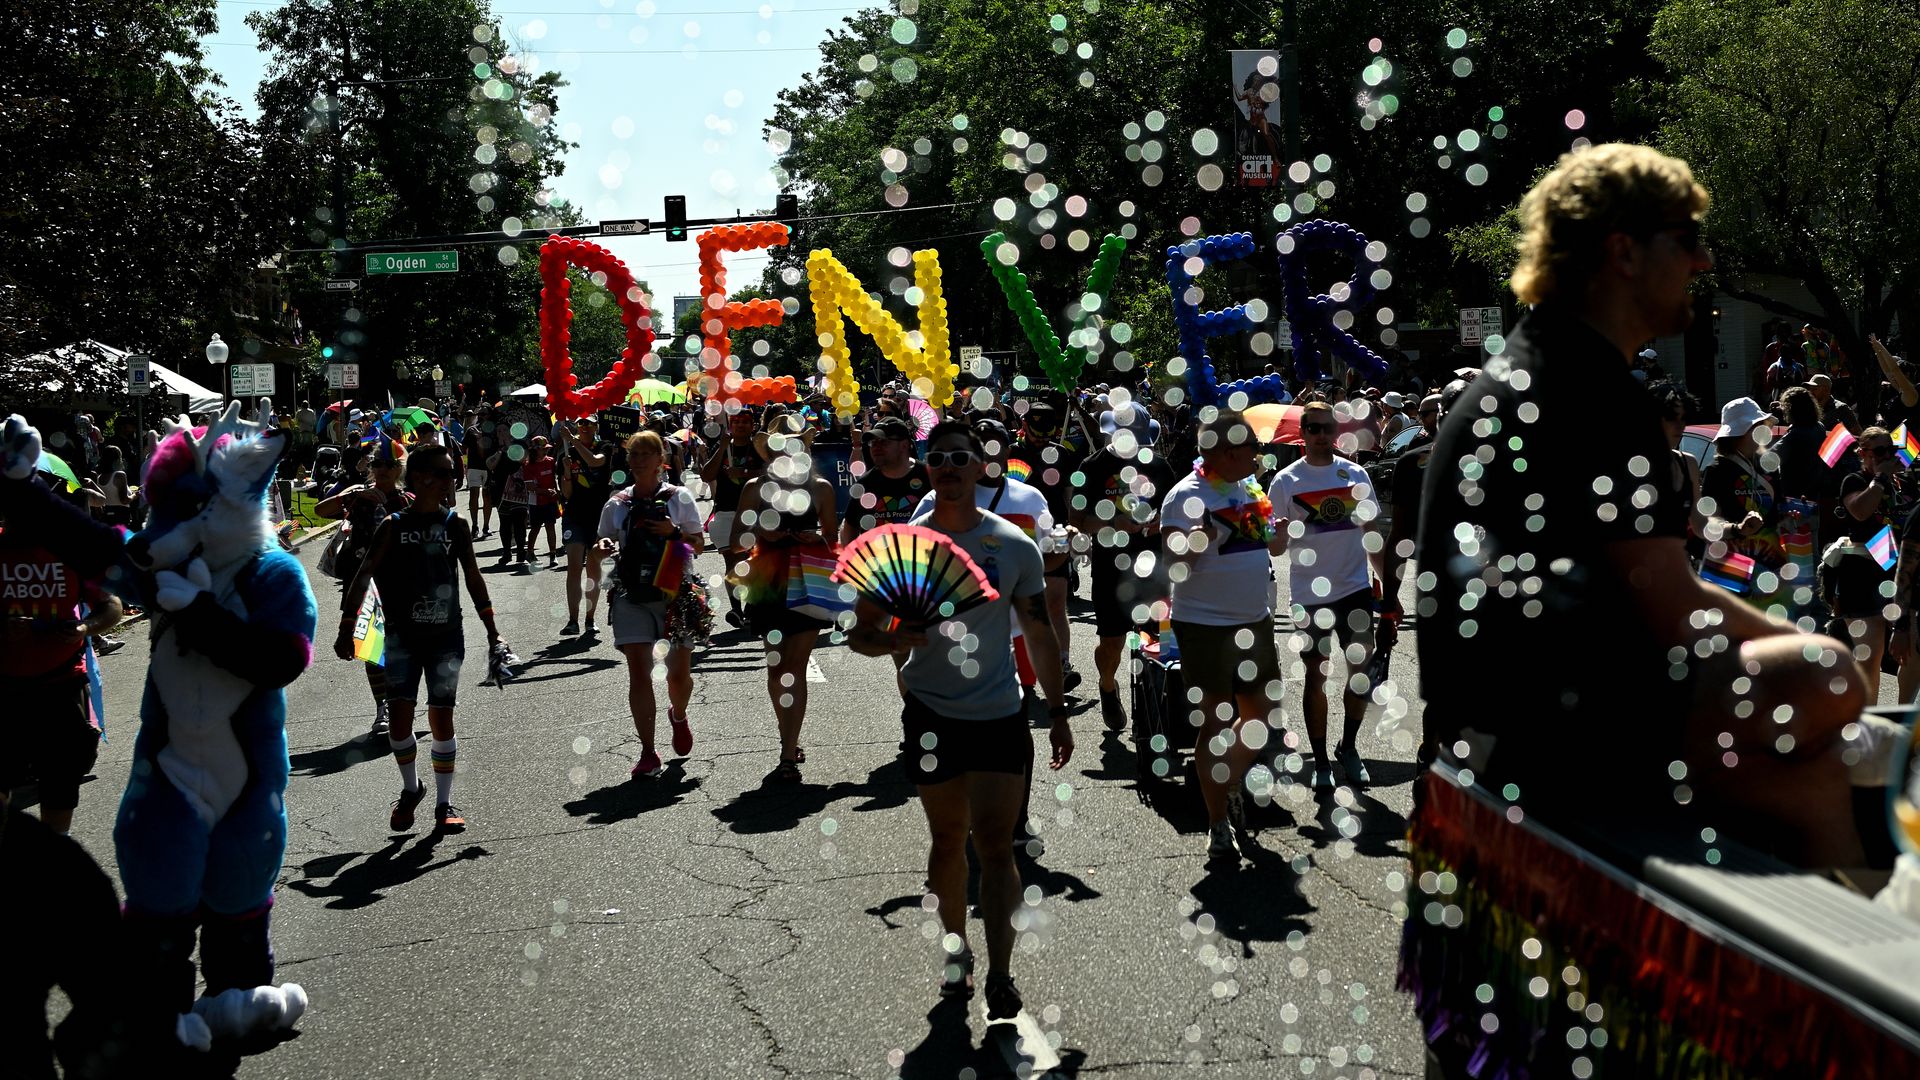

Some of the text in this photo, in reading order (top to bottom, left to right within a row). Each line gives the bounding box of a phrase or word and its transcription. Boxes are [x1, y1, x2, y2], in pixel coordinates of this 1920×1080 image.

[1242, 155, 1273, 173] art
[386, 256, 427, 272] Ogden
[540, 218, 1391, 418] DENVER
[1467, 311, 1475, 319] NO
[1483, 312, 1488, 321] 2
[963, 360, 980, 370] 30
[232, 367, 238, 377] 2
[603, 413, 631, 424] BETTER
[609, 422, 620, 430] TO
[615, 431, 630, 439] KNO
[1105, 488, 1117, 496] Out
[892, 511, 912, 519] Proud
[400, 530, 453, 545] EQUAL
[2, 562, 66, 582] LOVE
[2, 583, 67, 599] ABOVE
